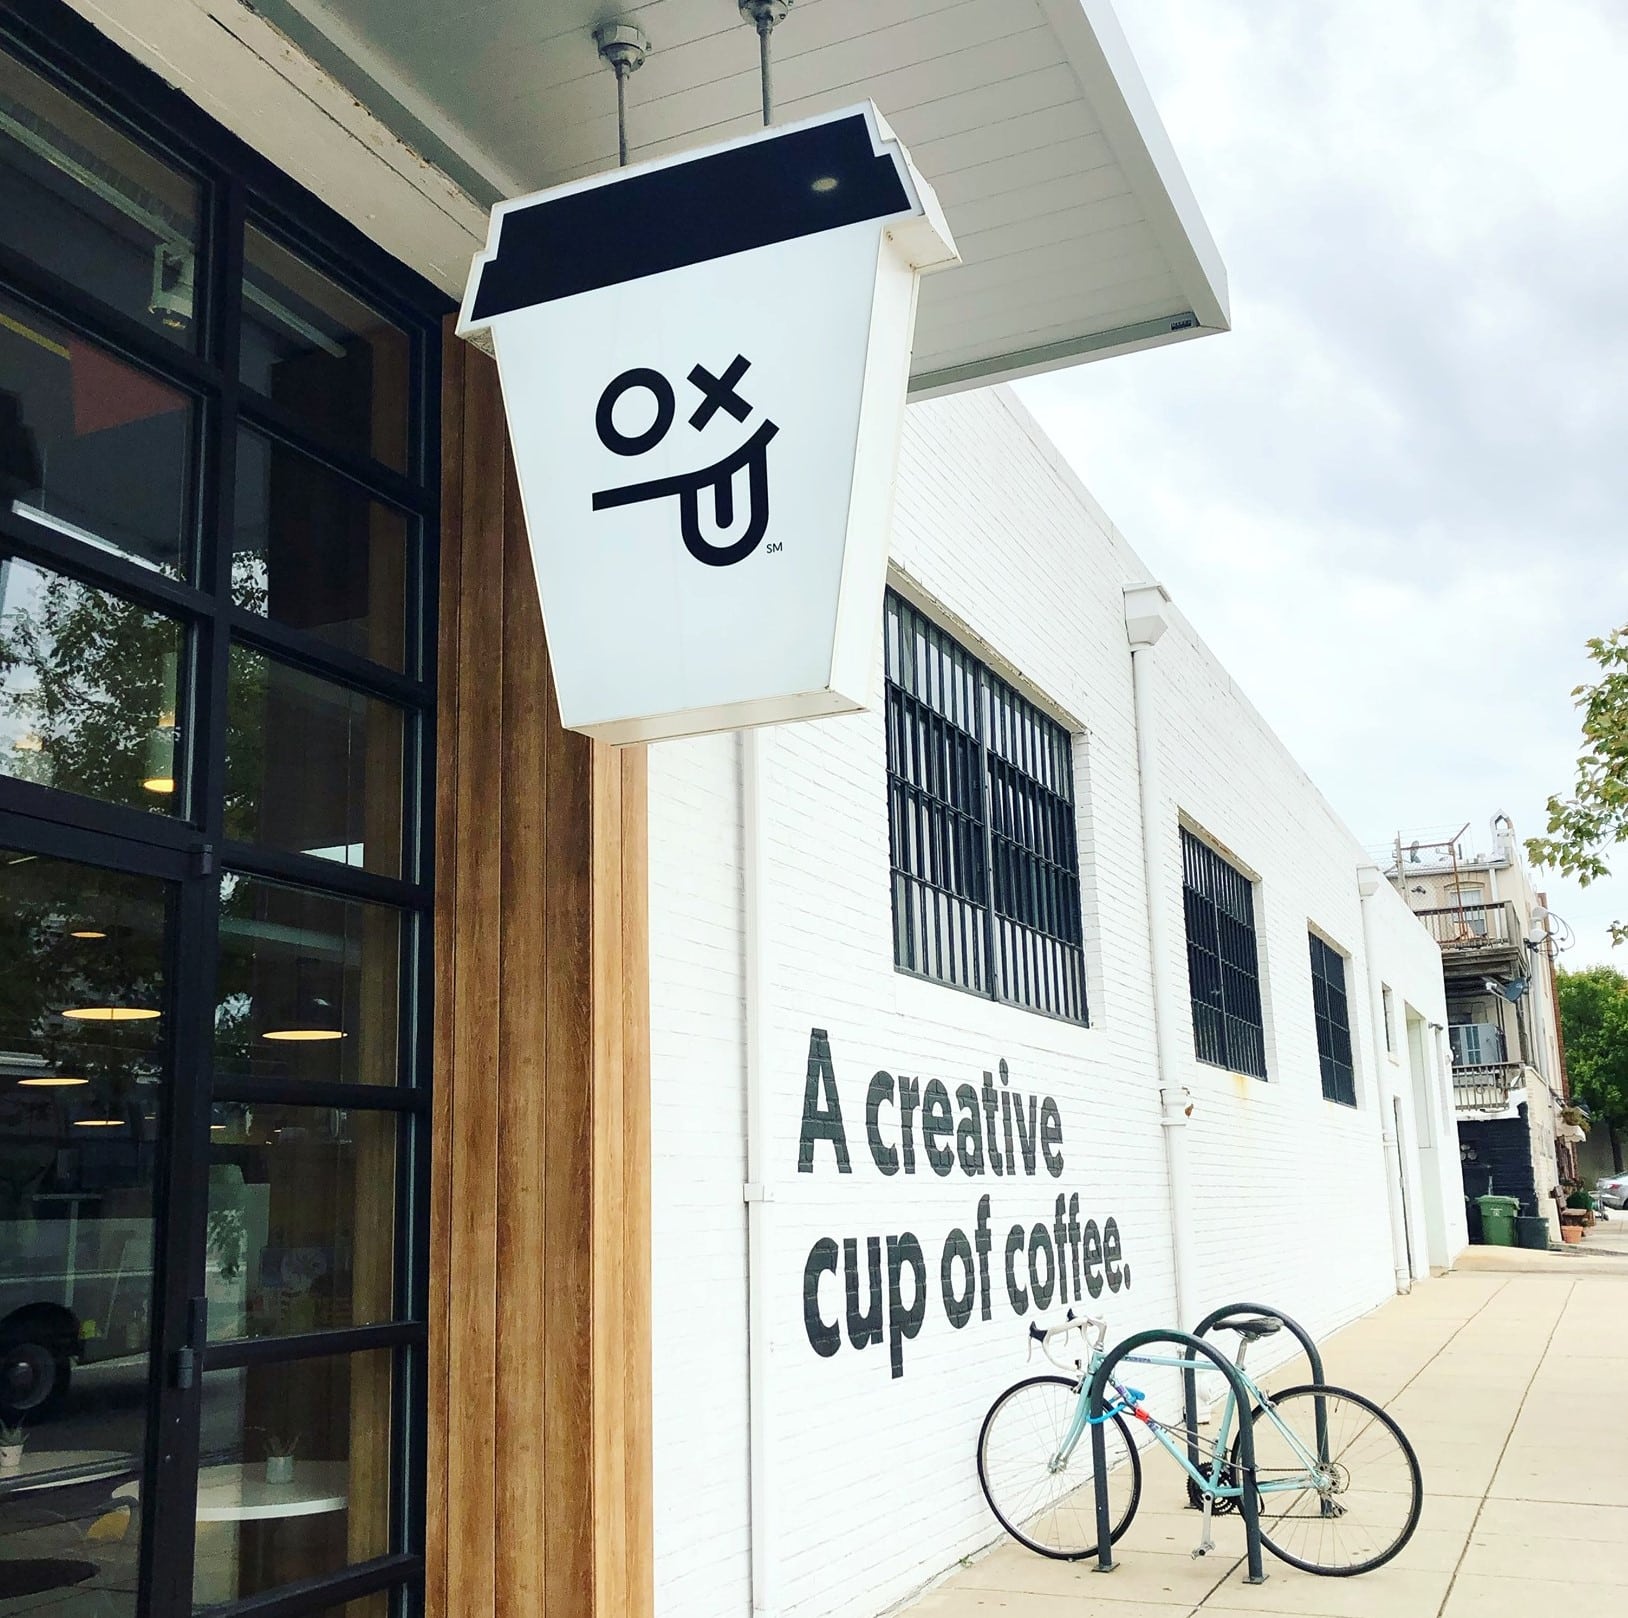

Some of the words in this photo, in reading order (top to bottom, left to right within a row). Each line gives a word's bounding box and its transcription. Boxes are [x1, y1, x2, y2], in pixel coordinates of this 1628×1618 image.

[766, 541, 783, 554] SM
[798, 1028, 852, 1173] A
[866, 1058, 1064, 1178] creative
[803, 1232, 926, 1379] cup
[941, 1194, 992, 1329] of
[1005, 1192, 1131, 1316] coffee.
